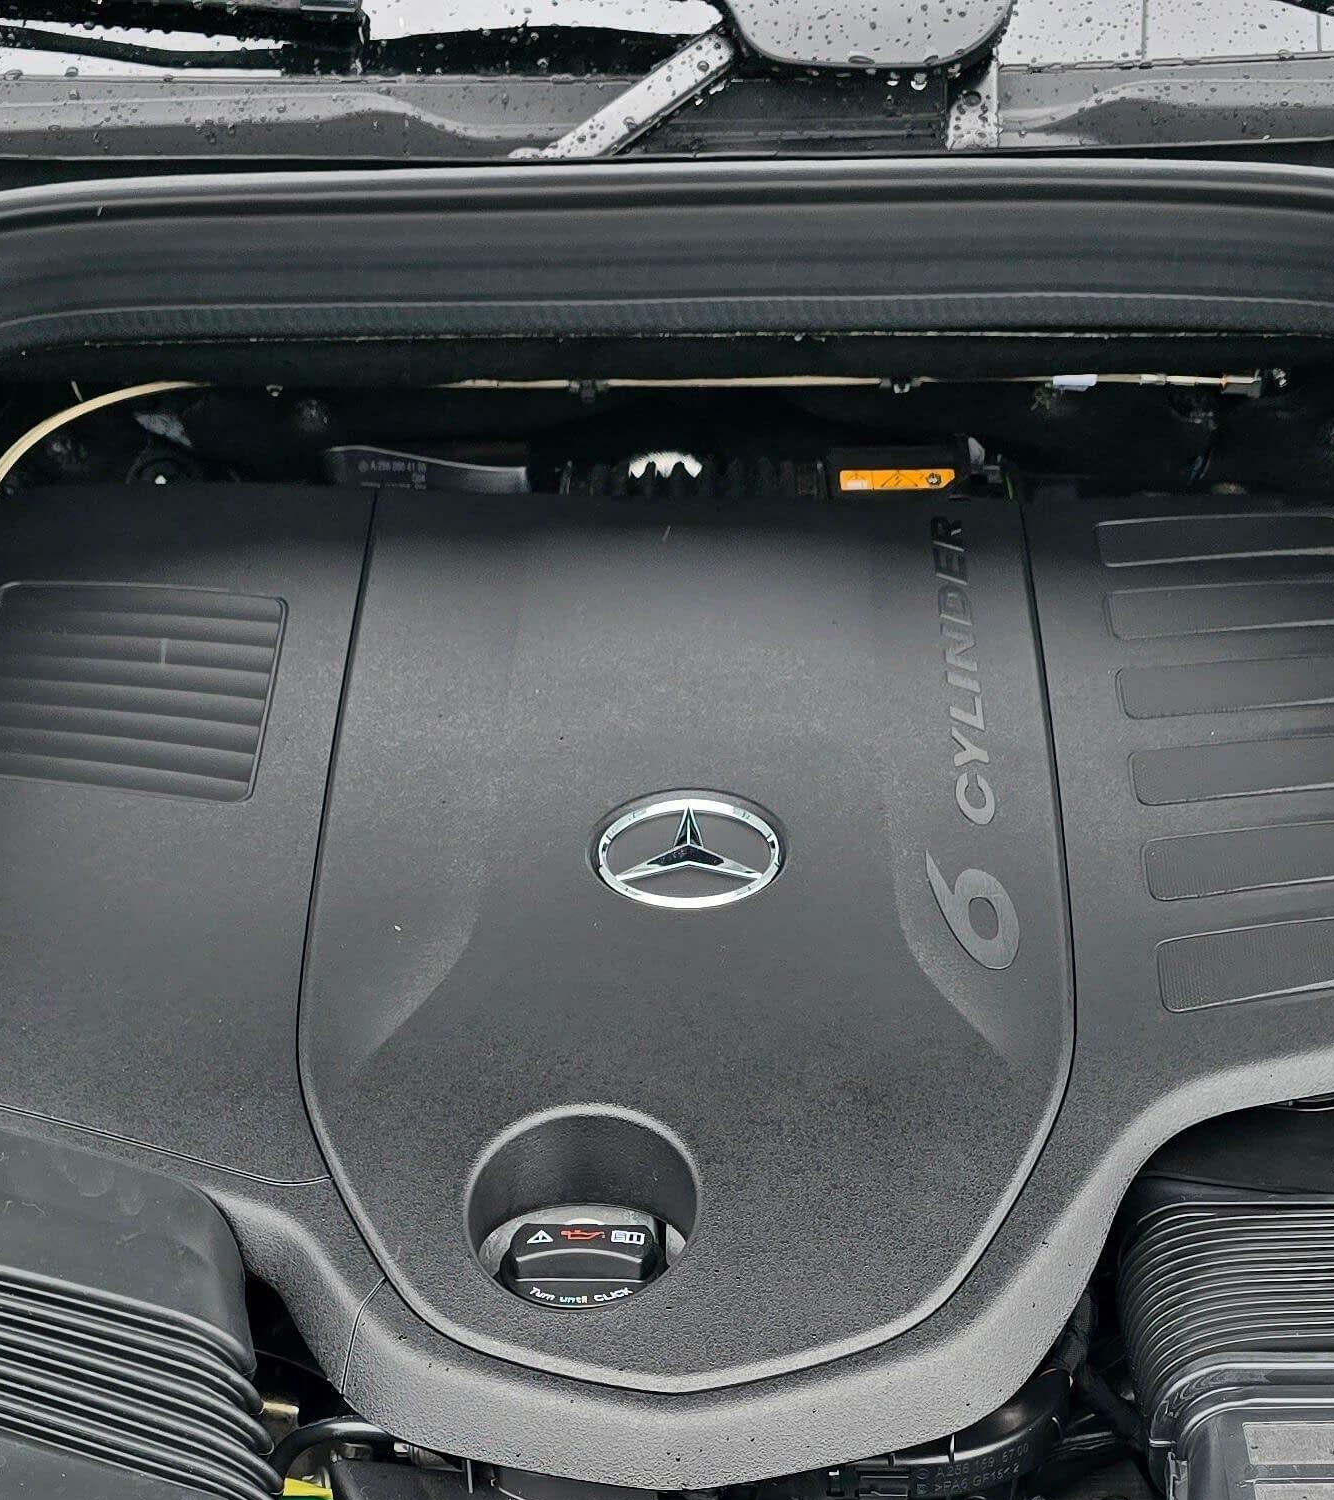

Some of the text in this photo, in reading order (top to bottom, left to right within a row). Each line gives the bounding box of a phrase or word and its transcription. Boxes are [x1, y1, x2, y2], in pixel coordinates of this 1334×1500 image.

[925, 515, 1020, 970] 6 CYLINDER
[529, 1287, 555, 1301] Turn
[593, 1287, 634, 1302] CLICK
